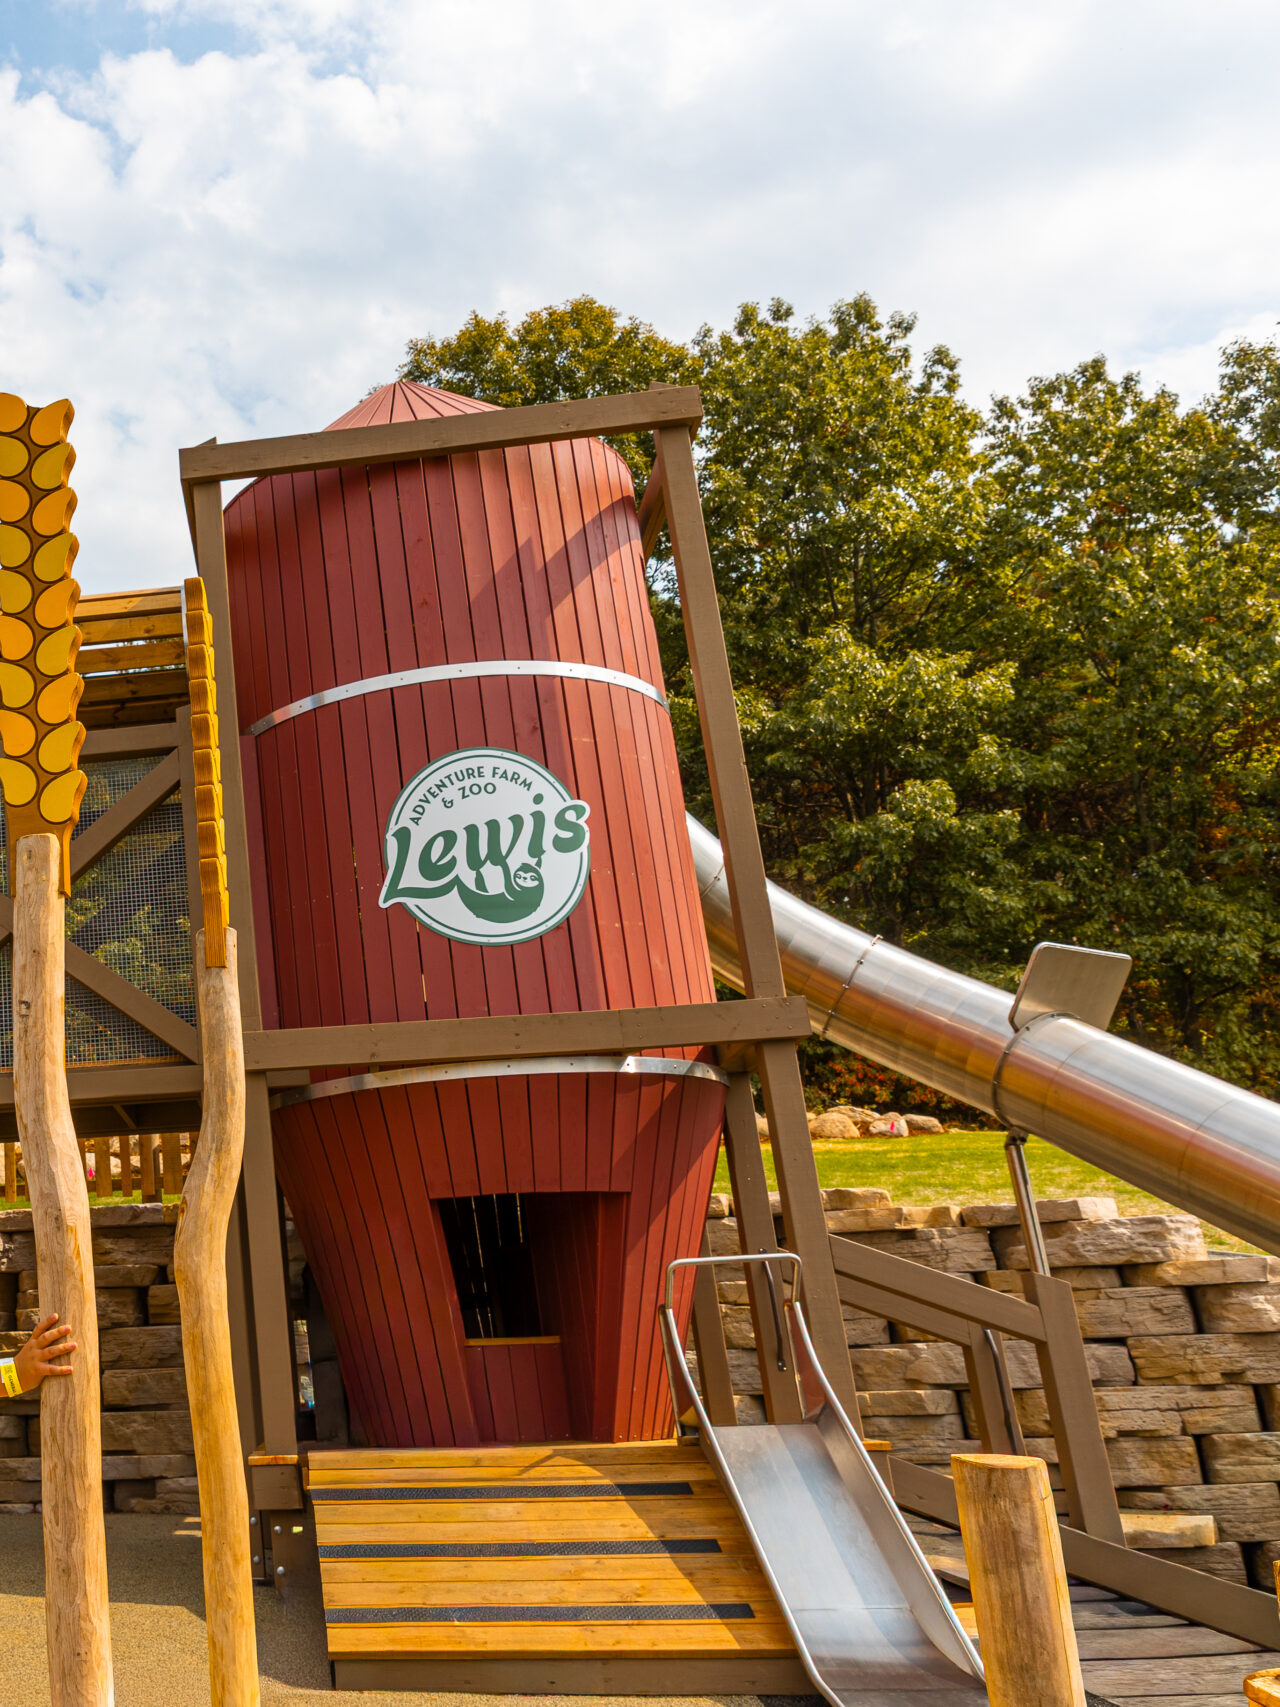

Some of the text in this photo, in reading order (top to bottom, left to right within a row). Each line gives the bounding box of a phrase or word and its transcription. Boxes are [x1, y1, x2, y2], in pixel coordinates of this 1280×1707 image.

[409, 766, 533, 826] ADVENTURE FARM
[443, 782, 497, 809] & ZOO
[383, 793, 587, 904] Lewis
